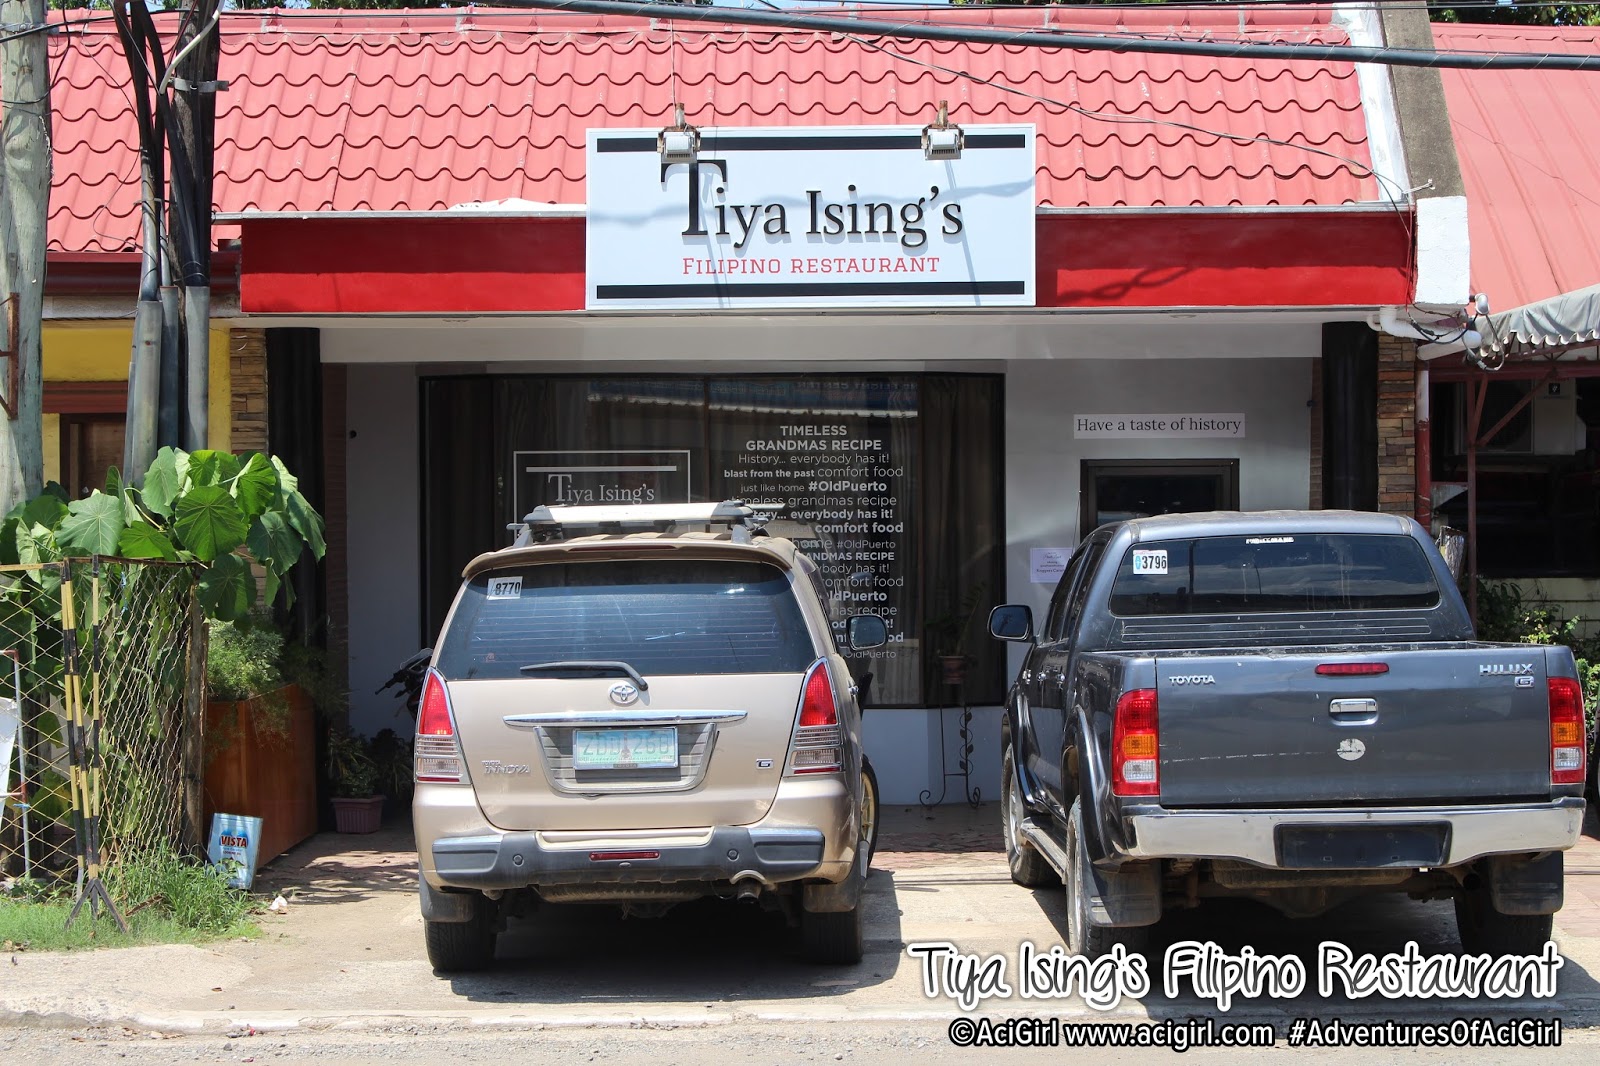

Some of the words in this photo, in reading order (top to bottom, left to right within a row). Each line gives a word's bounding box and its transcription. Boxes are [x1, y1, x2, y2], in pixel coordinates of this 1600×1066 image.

[660, 158, 789, 249] Tiya
[806, 184, 963, 248] Ising's
[682, 257, 781, 275] FILIPINO
[790, 257, 940, 274] RESTAURANT
[780, 425, 848, 436] TIMELESS
[1077, 419, 1113, 432] Have
[1117, 422, 1125, 431] a
[1130, 419, 1166, 431] taste
[1170, 418, 1185, 431] of
[1189, 418, 1242, 435] history
[745, 440, 827, 451] GRANDMAS
[831, 440, 882, 451] RECIPE
[738, 453, 786, 465] History...
[790, 453, 852, 465] everybody
[855, 453, 875, 463] has
[878, 453, 890, 463] it!
[724, 469, 748, 478] blast
[750, 469, 773, 478] from
[775, 469, 792, 477] the
[793, 469, 815, 479] past
[817, 465, 869, 477] comfort
[873, 465, 904, 477] food
[547, 473, 593, 506] Tiya
[599, 484, 655, 505] Ising's
[740, 484, 758, 494] just
[760, 483, 776, 492] like
[778, 483, 805, 492] home
[808, 480, 888, 492] #OldPuerto
[731, 495, 784, 505] tmeless
[788, 494, 854, 507] grandmas
[857, 495, 897, 508] recipe
[752, 510, 787, 520] tory...
[790, 508, 854, 520] everybody
[857, 509, 878, 519] has
[880, 509, 893, 519] it!
[815, 522, 869, 533] comfort
[872, 522, 904, 533] food
[836, 539, 896, 549] #OldPuerto
[805, 552, 853, 561] ANDMAS
[855, 551, 895, 561] RECIPE
[1142, 555, 1167, 569] 3796
[855, 563, 876, 573] has
[879, 563, 890, 573] it!
[822, 575, 870, 587] omfort
[873, 575, 904, 587] food
[494, 582, 521, 596] 8770
[829, 590, 888, 601] ldPuerto
[856, 604, 898, 617] recipe
[1479, 663, 1534, 676] HILUX
[1169, 674, 1216, 685] TOYOTA
[220, 835, 248, 848] VISTA
